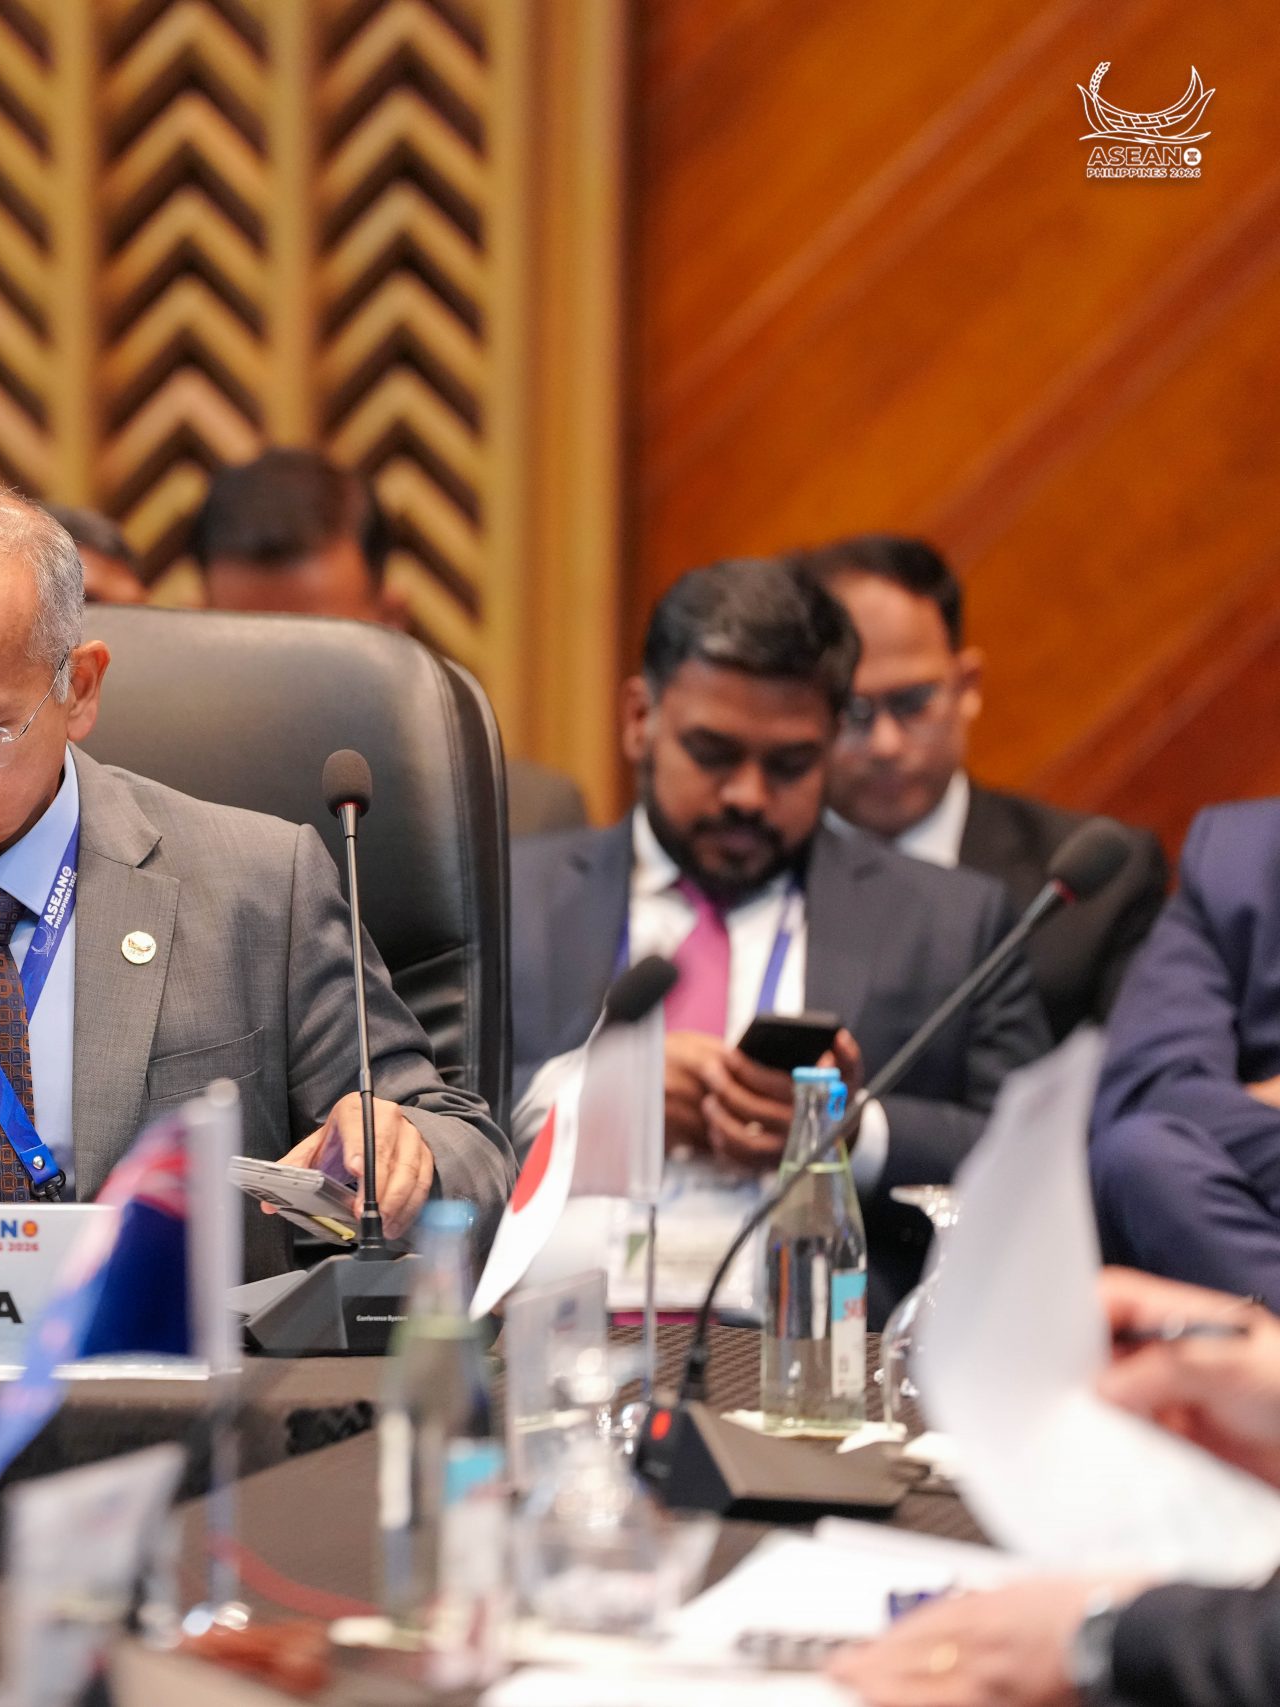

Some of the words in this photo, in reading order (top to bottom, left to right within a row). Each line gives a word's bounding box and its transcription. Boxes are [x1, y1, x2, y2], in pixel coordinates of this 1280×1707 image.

[43, 874, 69, 927] ASEAN
[53, 888, 73, 929] PHILIPPINES
[8, 1241, 39, 1252] 2026
